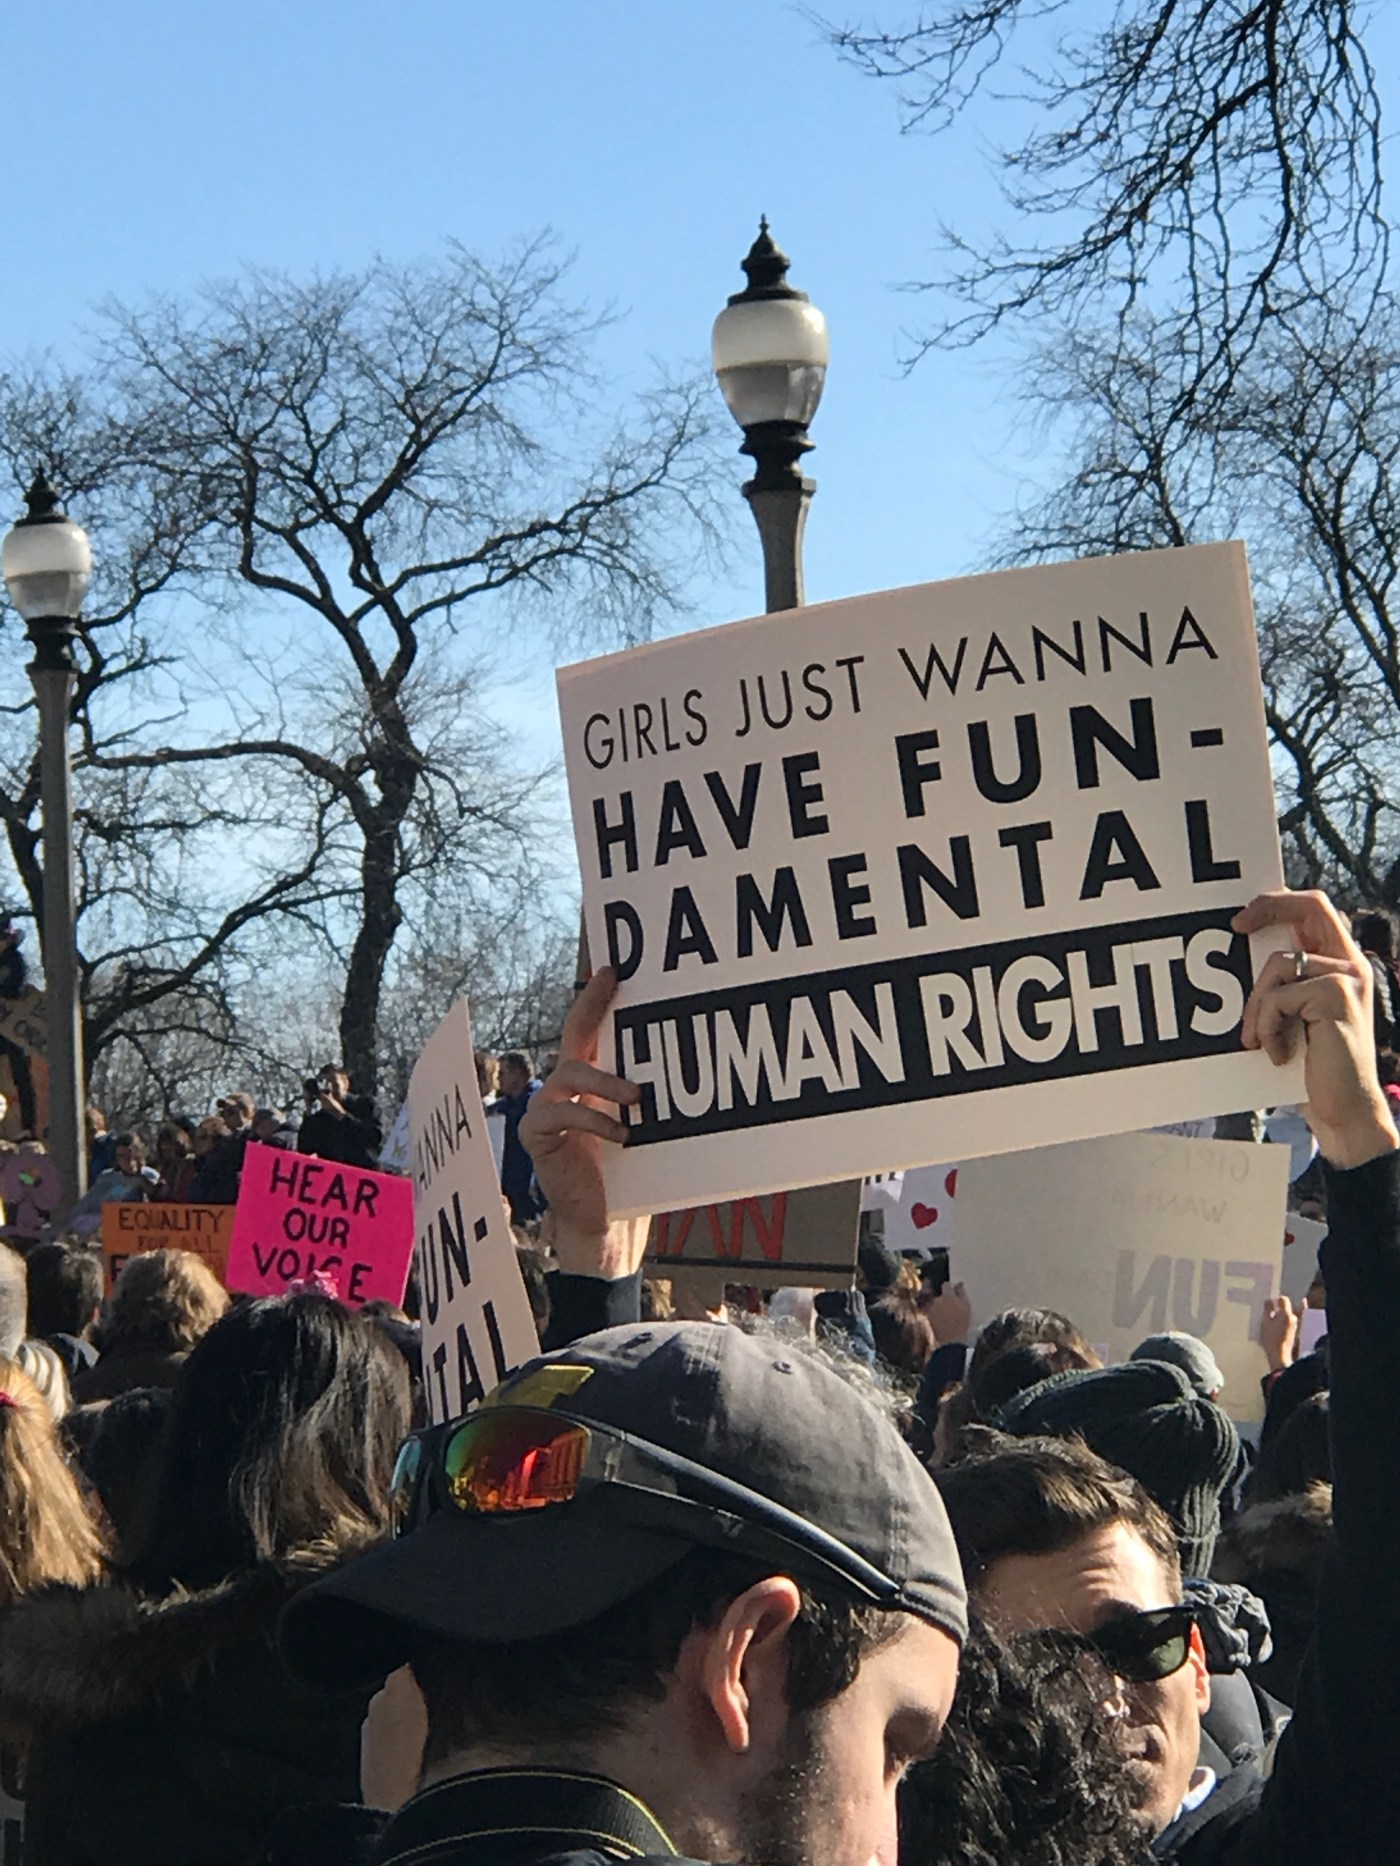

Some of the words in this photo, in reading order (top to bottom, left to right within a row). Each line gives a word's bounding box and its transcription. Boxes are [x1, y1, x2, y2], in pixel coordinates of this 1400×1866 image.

[584, 688, 708, 770] GIRLS
[735, 655, 865, 738] JUST
[897, 605, 1219, 702] WANNA
[592, 751, 830, 880] HAVE
[894, 696, 1224, 819] FUN-
[603, 799, 1242, 982] DAMENTAL
[621, 981, 906, 1127] HUMAN
[918, 927, 1245, 1077] RIGHTS
[269, 1157, 380, 1219] HEAR
[417, 1082, 472, 1191] ANNA
[118, 1207, 224, 1234] EQUALITY
[283, 1207, 350, 1250] OUR
[420, 1190, 489, 1327] UN-
